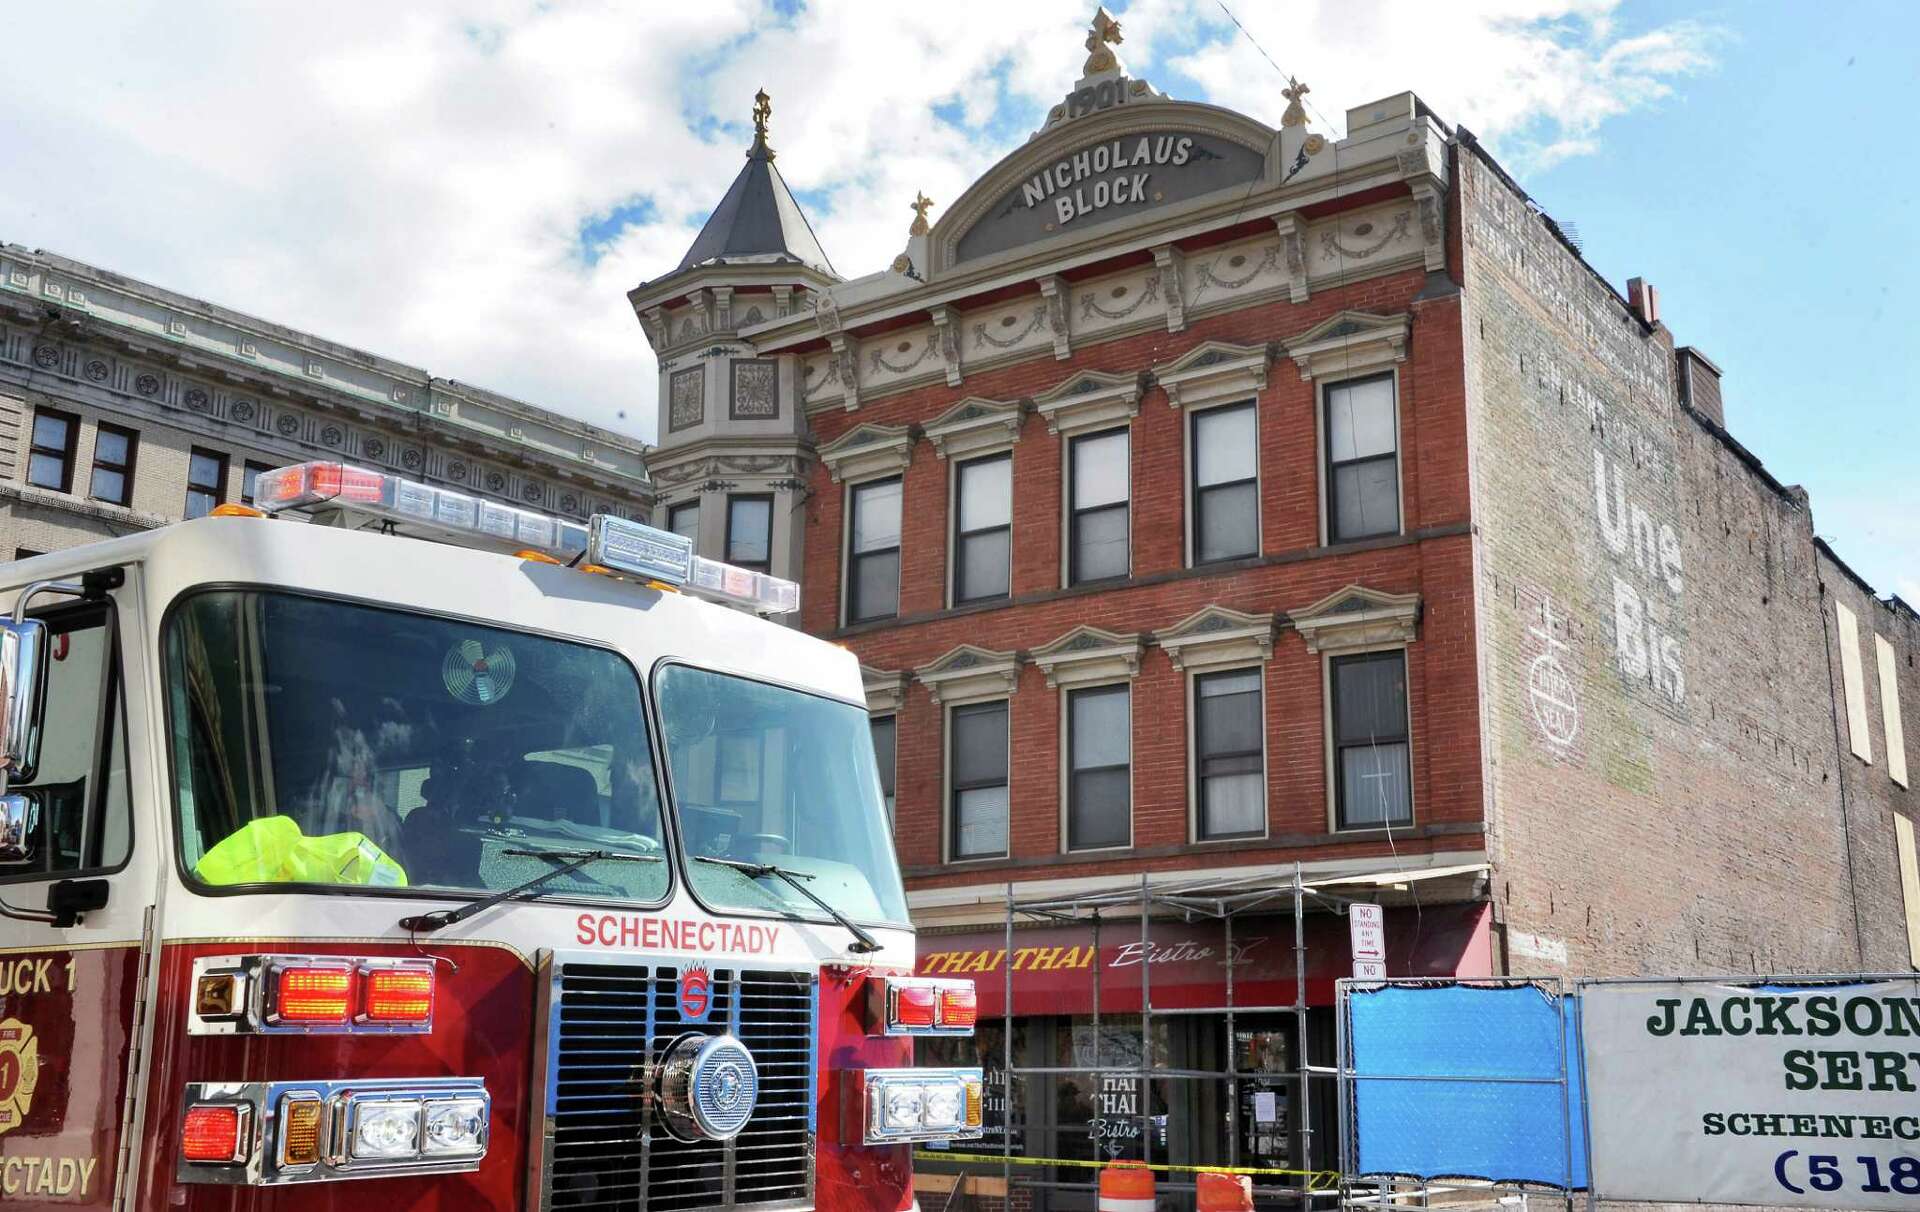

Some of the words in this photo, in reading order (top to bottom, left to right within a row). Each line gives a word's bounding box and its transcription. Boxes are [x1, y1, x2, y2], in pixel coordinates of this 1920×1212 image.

[1066, 76, 1128, 118] 1901
[1021, 136, 1193, 209] NICHOLAUS
[1054, 172, 1150, 225] BLOCK
[1594, 449, 1683, 593] Une
[1612, 575, 1686, 705] Bis
[576, 913, 780, 954] SCHENECTADY
[1359, 908, 1373, 919] NO
[65, 958, 77, 991] 1
[921, 949, 1007, 974] THAI
[1011, 945, 1096, 970] THAI
[1108, 939, 1216, 968] Bistro
[1363, 965, 1376, 976] NO
[1646, 995, 1920, 1037] JACKSON
[1, 1062, 9, 1090] 1
[1087, 1118, 1141, 1139] Bistro
[1702, 1112, 1920, 1141] SCHENEC
[0, 1156, 97, 1196] CTADY
